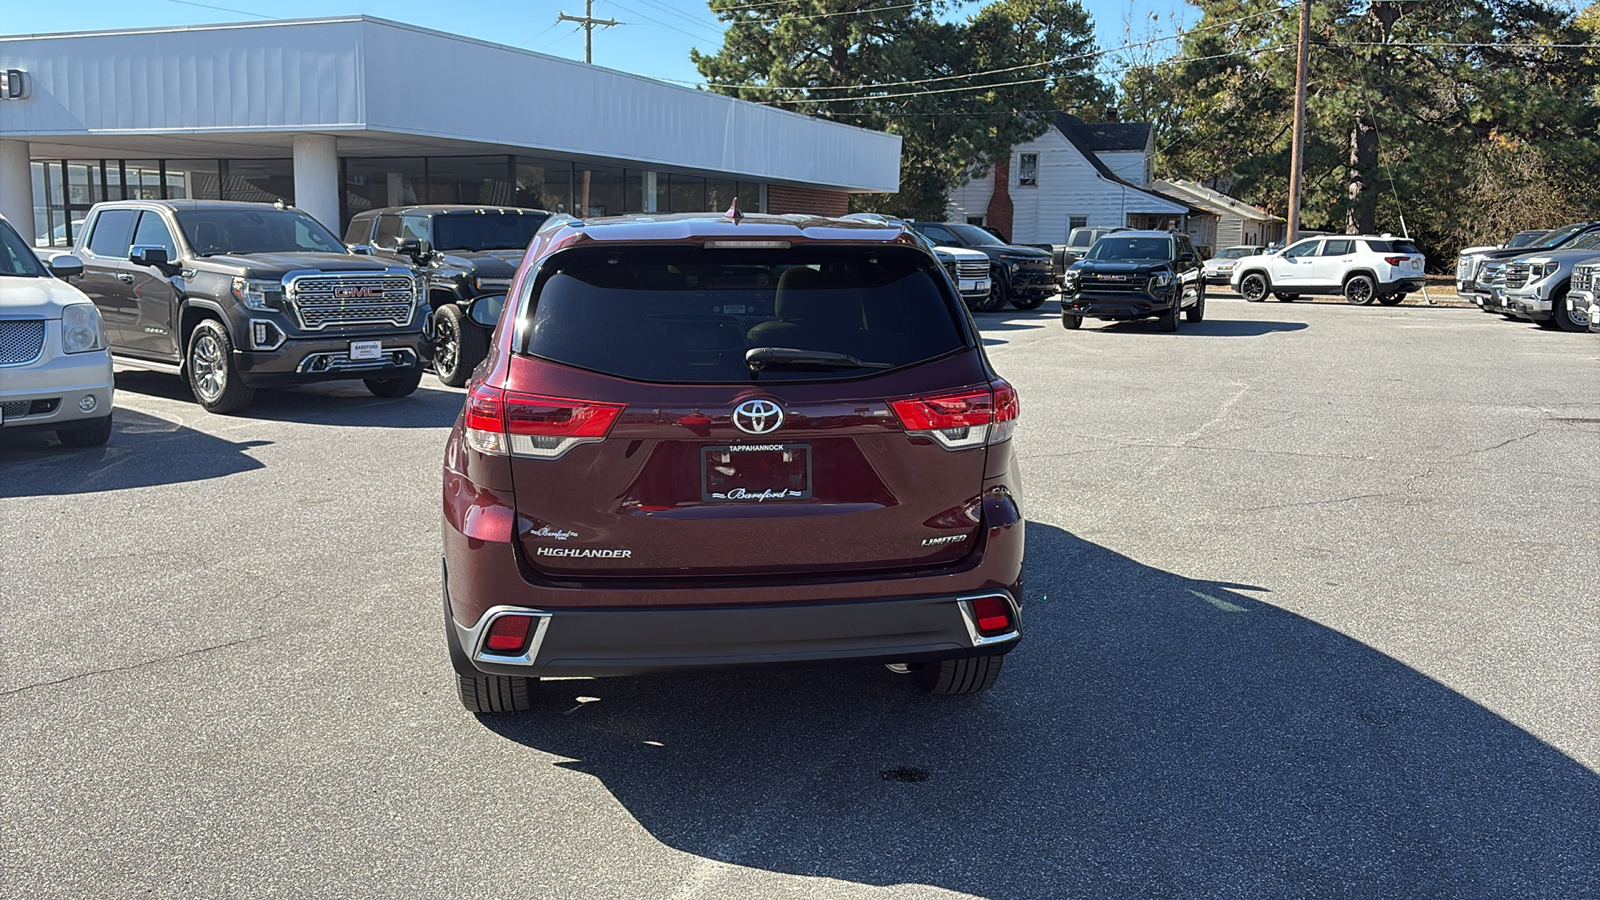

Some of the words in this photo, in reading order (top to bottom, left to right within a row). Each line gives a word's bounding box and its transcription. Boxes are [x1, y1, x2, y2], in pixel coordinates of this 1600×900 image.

[0, 69, 32, 100] D
[335, 287, 382, 297] GMC
[727, 488, 788, 502] Bareford
[538, 526, 571, 539] Bareford
[921, 534, 967, 546] LIMITED
[537, 547, 632, 558] HIGHLANDER
